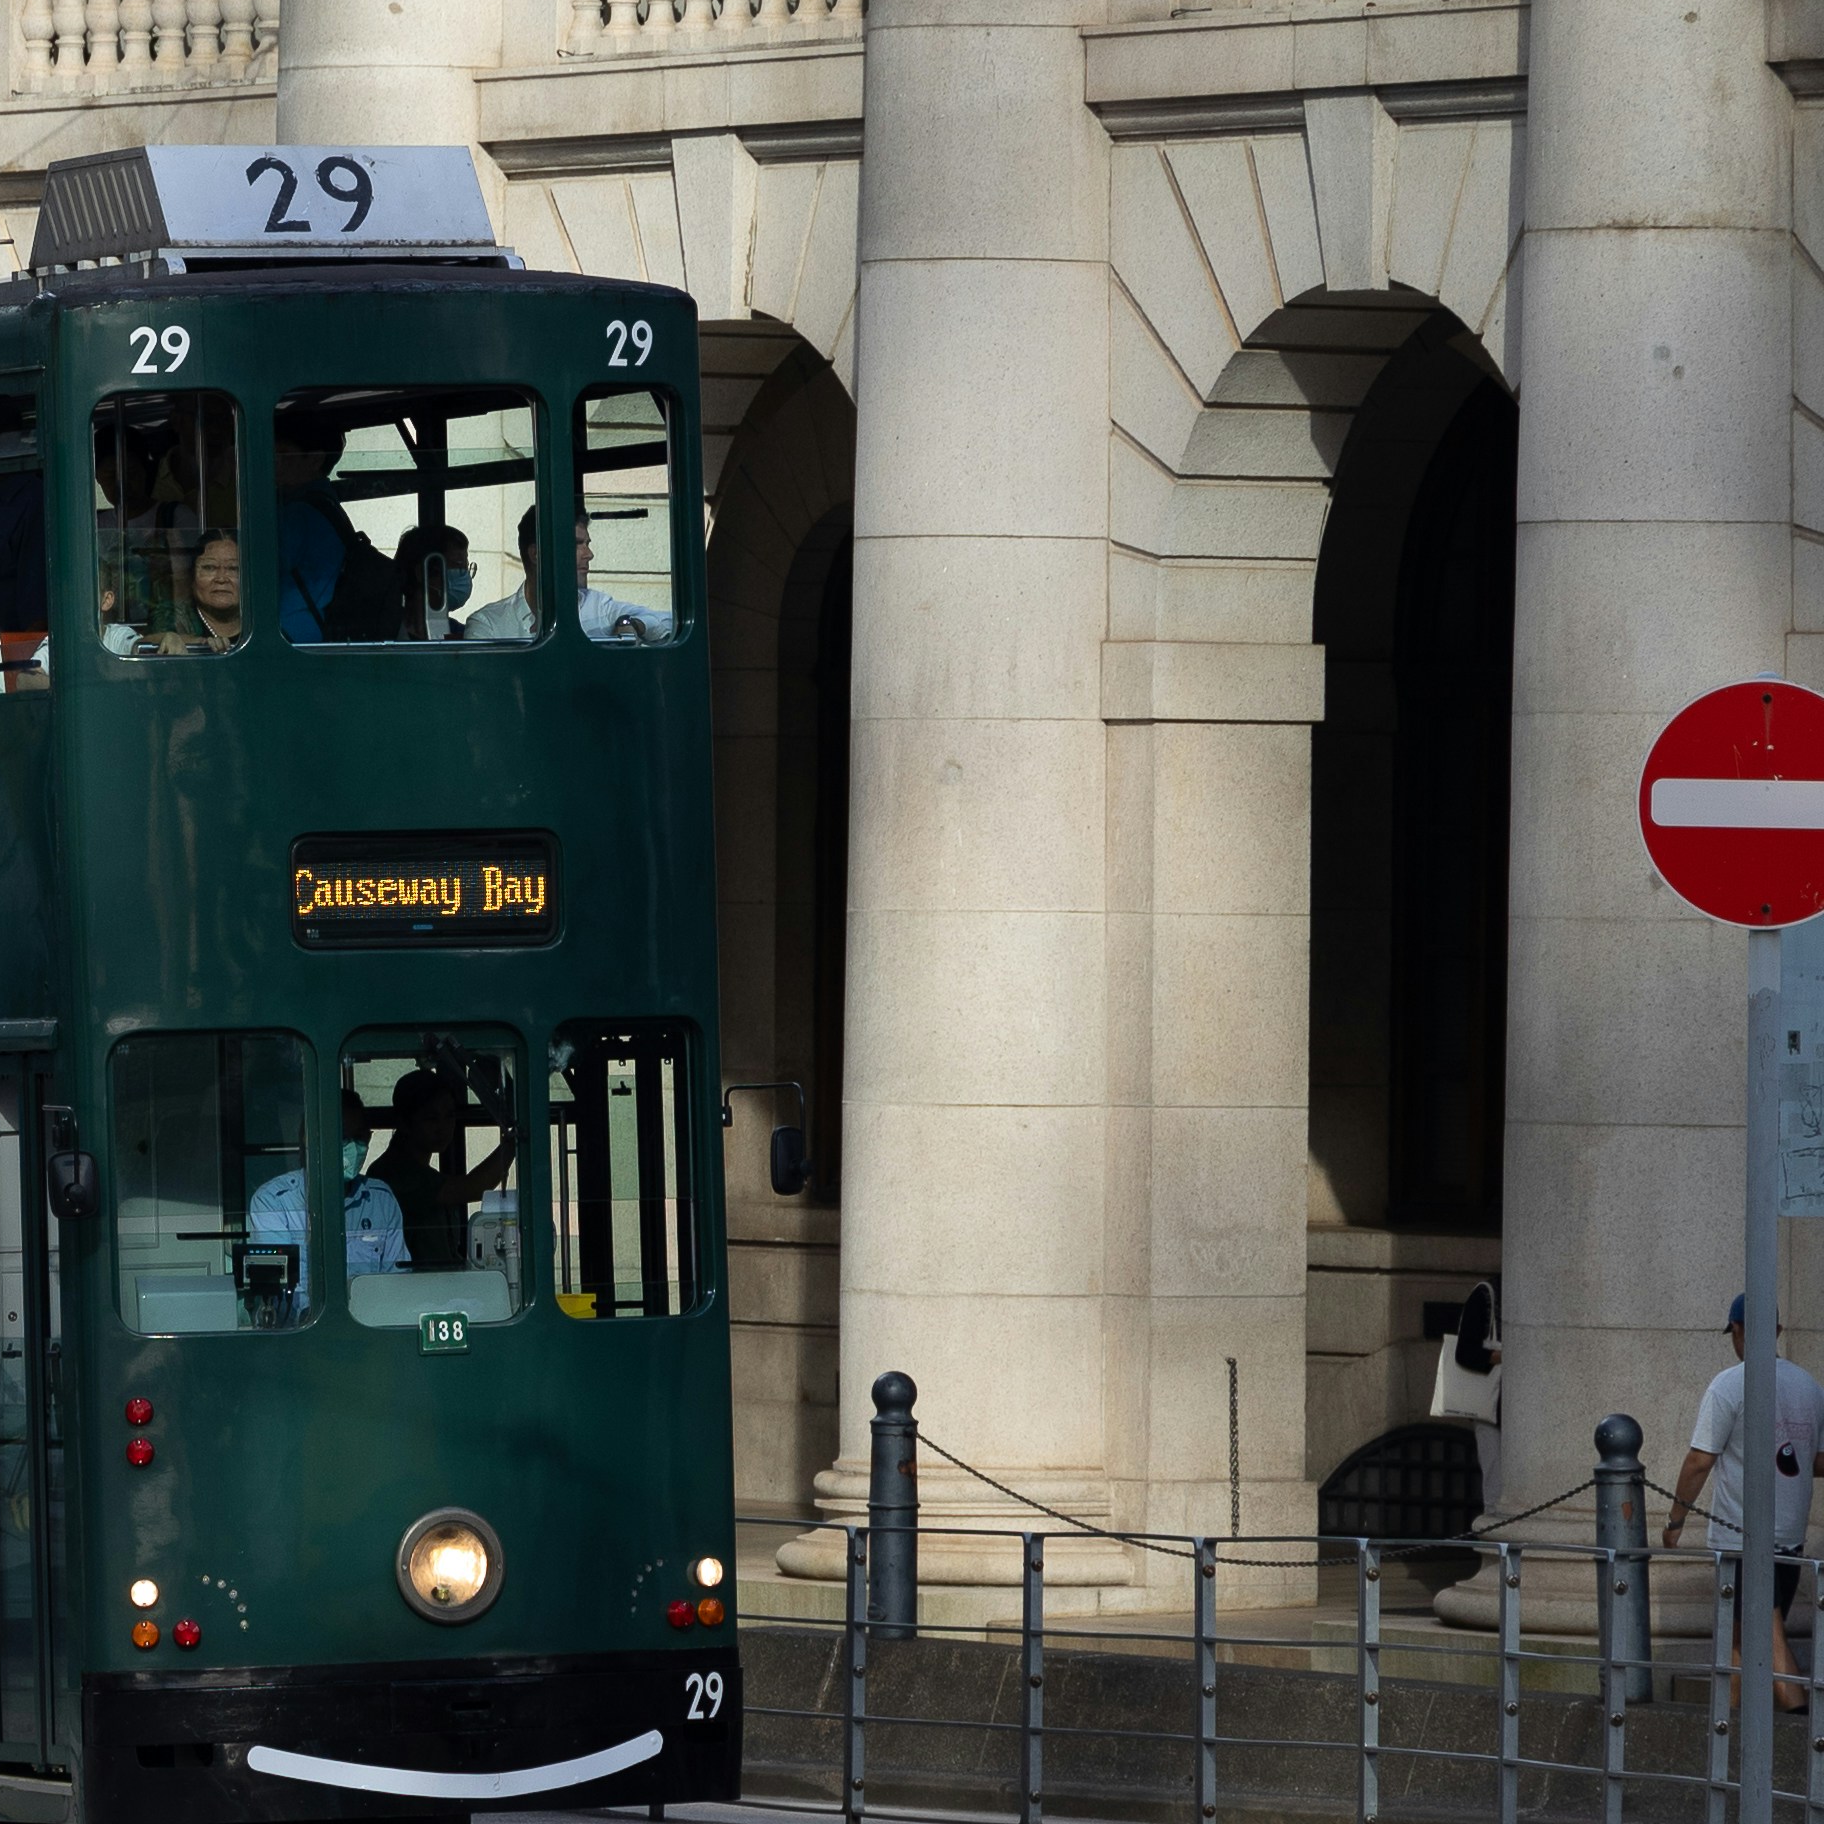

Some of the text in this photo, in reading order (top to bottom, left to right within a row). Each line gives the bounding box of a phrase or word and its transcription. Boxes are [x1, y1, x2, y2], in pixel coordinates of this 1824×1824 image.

[246, 156, 373, 232] 29
[130, 325, 190, 373] 29
[606, 320, 653, 366] 29
[296, 866, 545, 915] Causeway Bay
[429, 1320, 463, 1341] 138
[685, 1672, 723, 1719] 29
